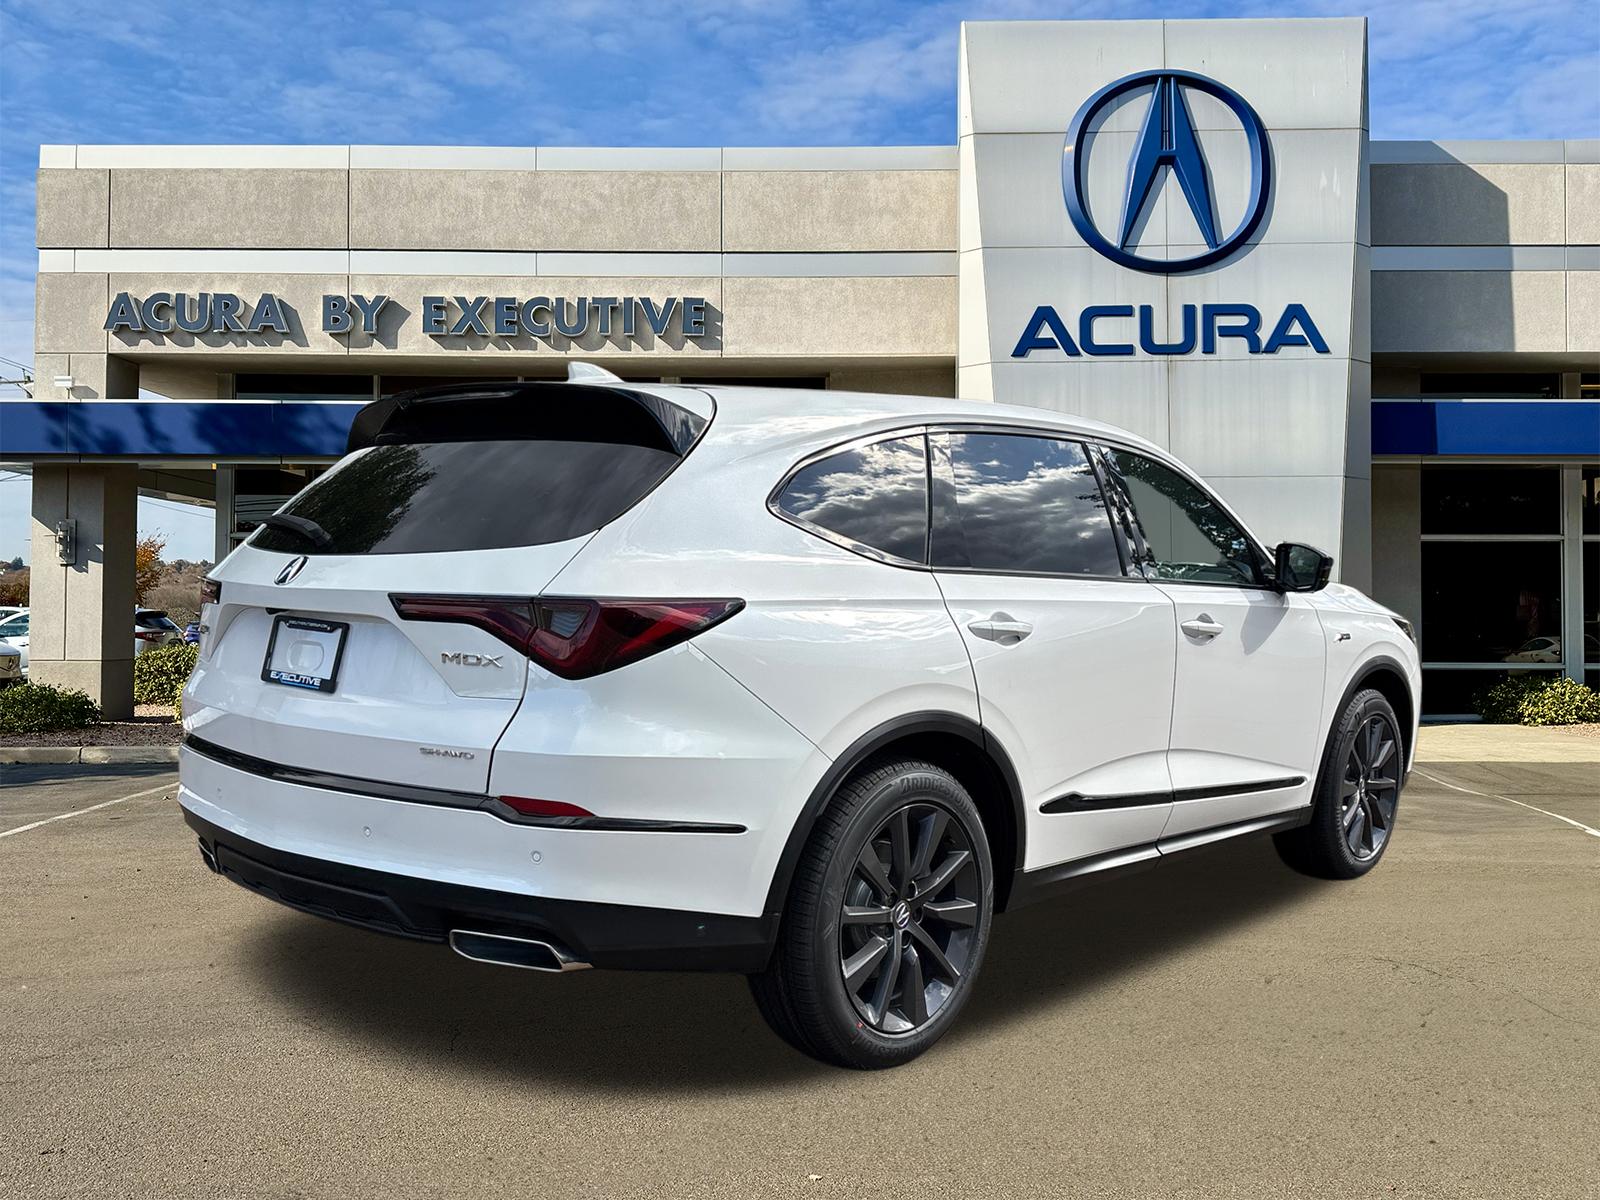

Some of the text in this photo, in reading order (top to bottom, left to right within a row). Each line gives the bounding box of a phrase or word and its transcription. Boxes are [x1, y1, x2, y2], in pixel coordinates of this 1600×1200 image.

[103, 292, 706, 338] ACURA BY EXECUTIVE
[1010, 303, 1332, 357] ACURA
[440, 651, 504, 669] MDX
[270, 671, 322, 686] EXECUTIVE
